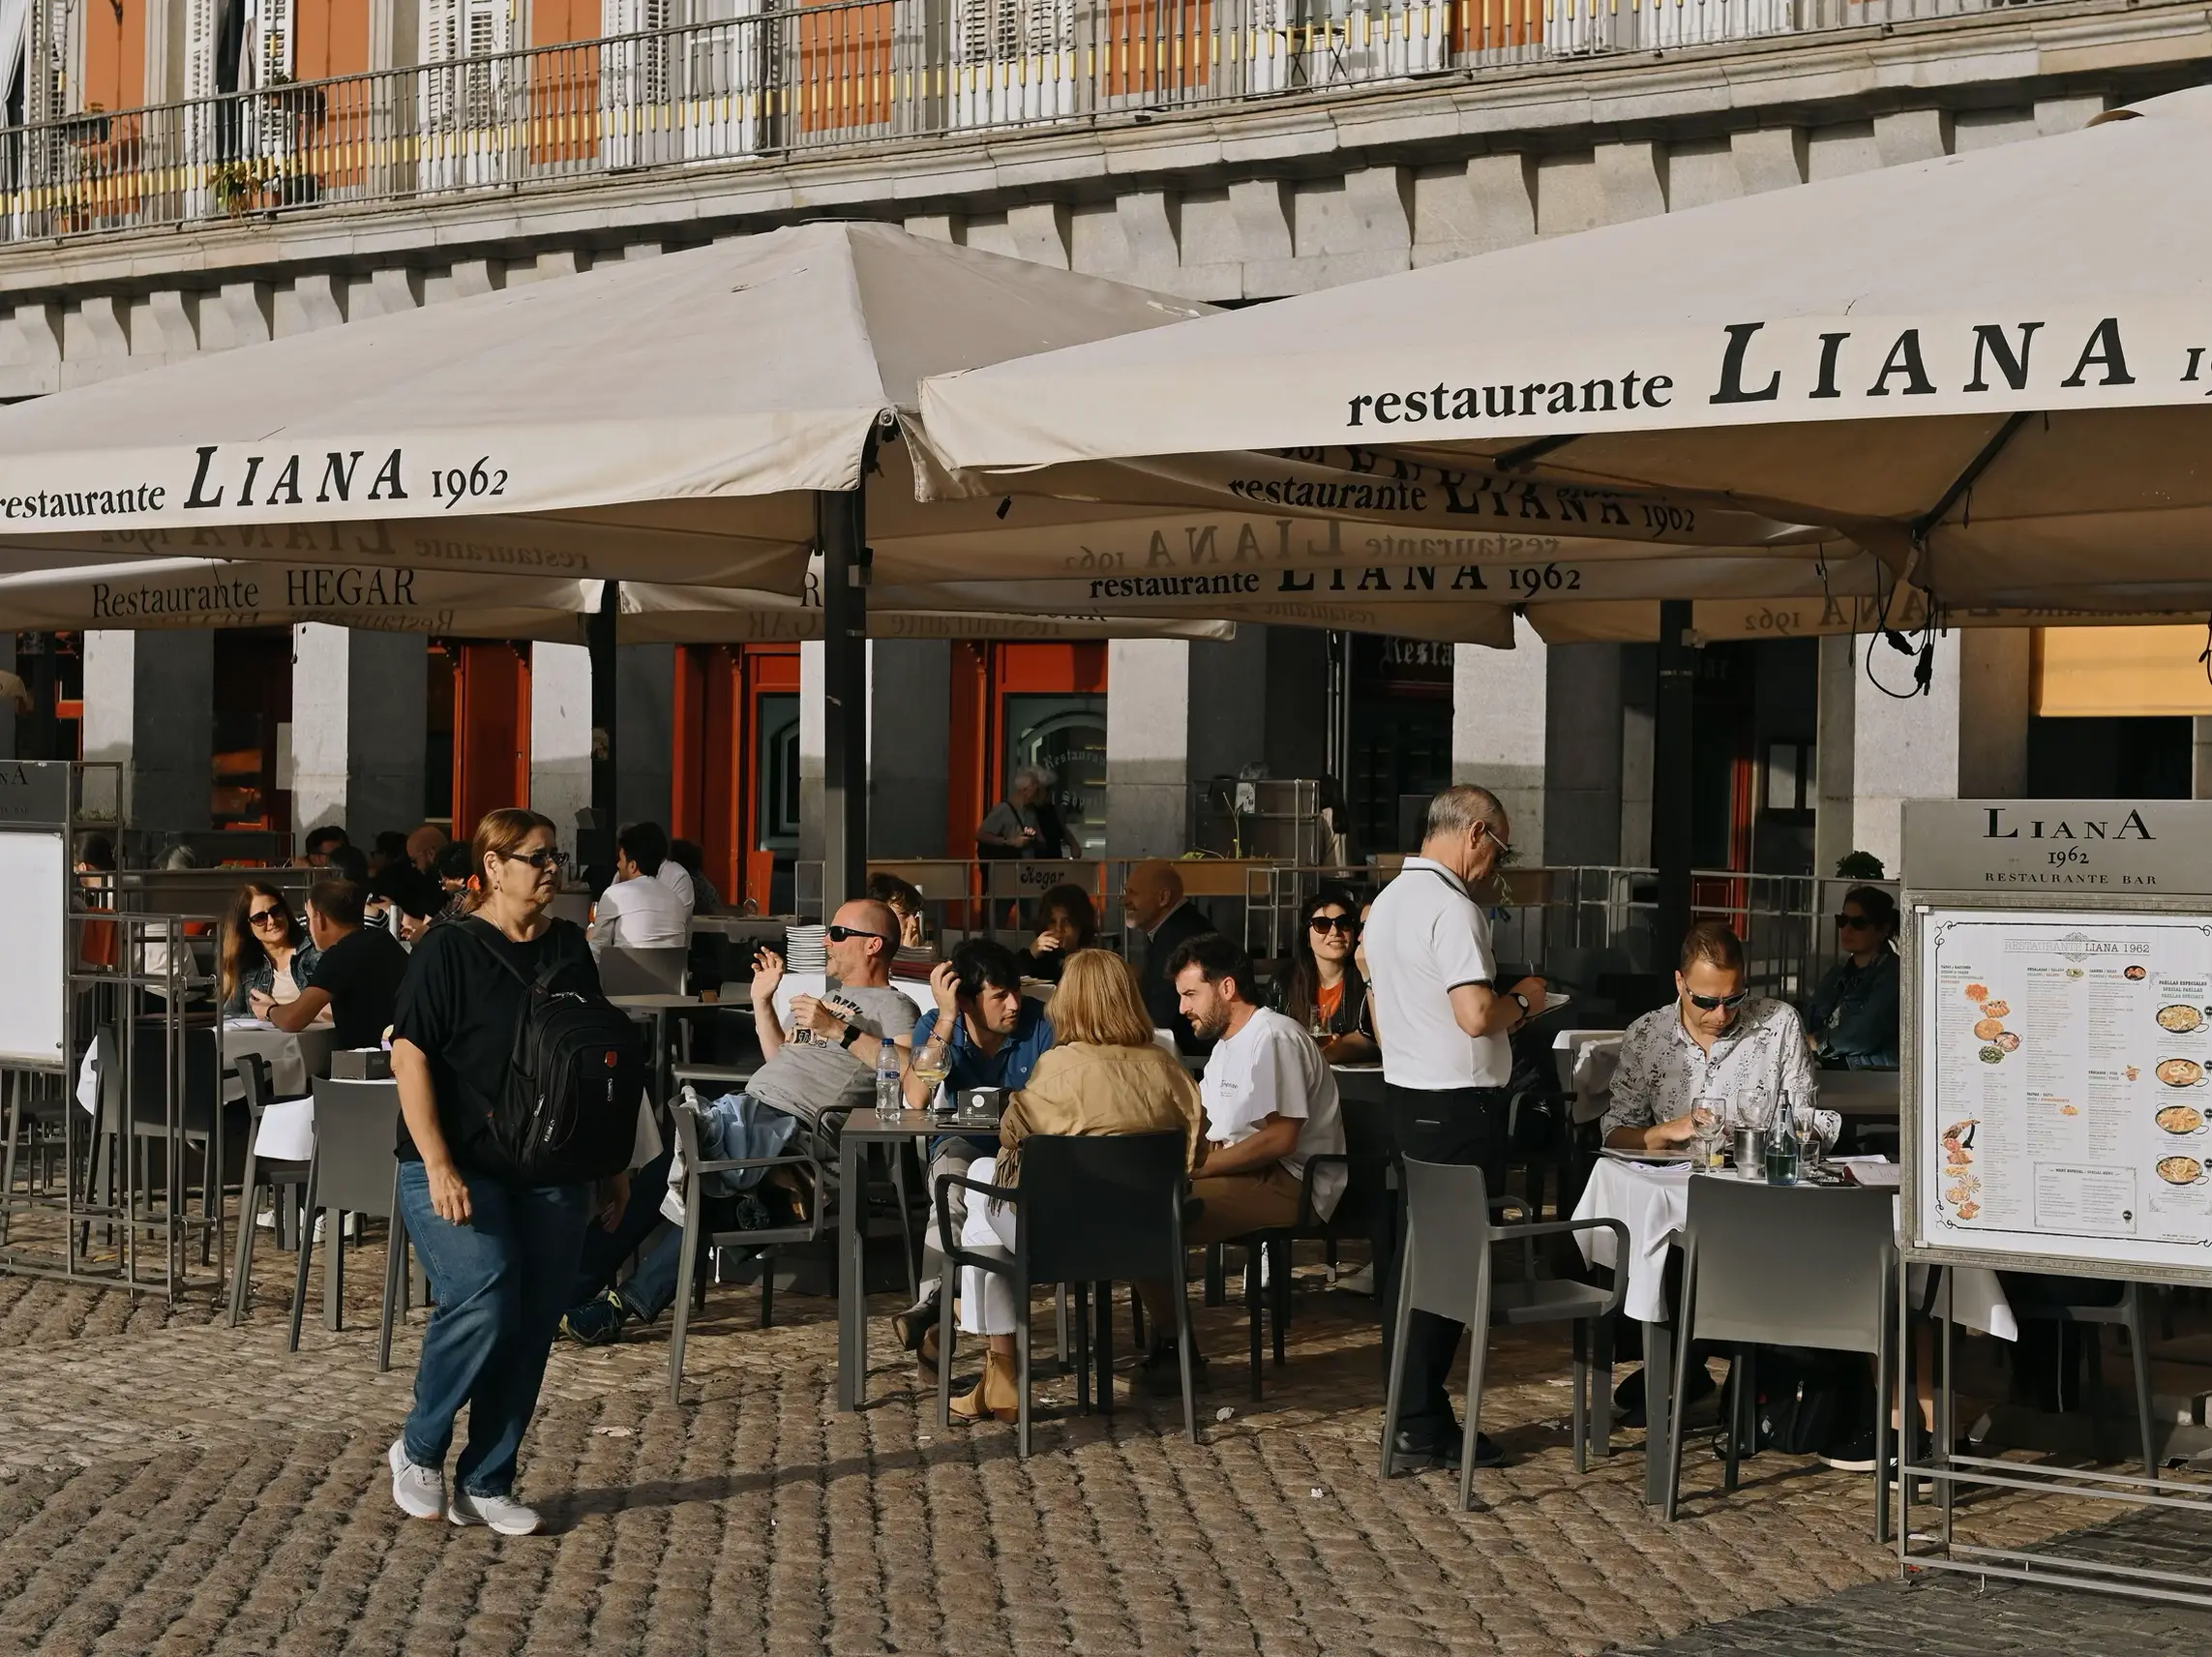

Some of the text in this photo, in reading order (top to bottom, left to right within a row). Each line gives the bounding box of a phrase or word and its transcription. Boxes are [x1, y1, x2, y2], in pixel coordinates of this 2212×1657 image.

[1347, 317, 2212, 427] restaurante LIANA 1
[184, 446, 408, 509] LIANA
[433, 455, 509, 509] 1962
[1229, 475, 1428, 511] restaurante
[93, 568, 418, 618] Restaurante HEGAR
[1090, 566, 1259, 600] restaurante
[1510, 562, 1582, 600] 1962
[2048, 845, 2090, 868] 1962
[1985, 872, 2158, 886] RESTAURANTE BAR
[2004, 941, 2150, 953] RESTAURANTE LIANA 1962
